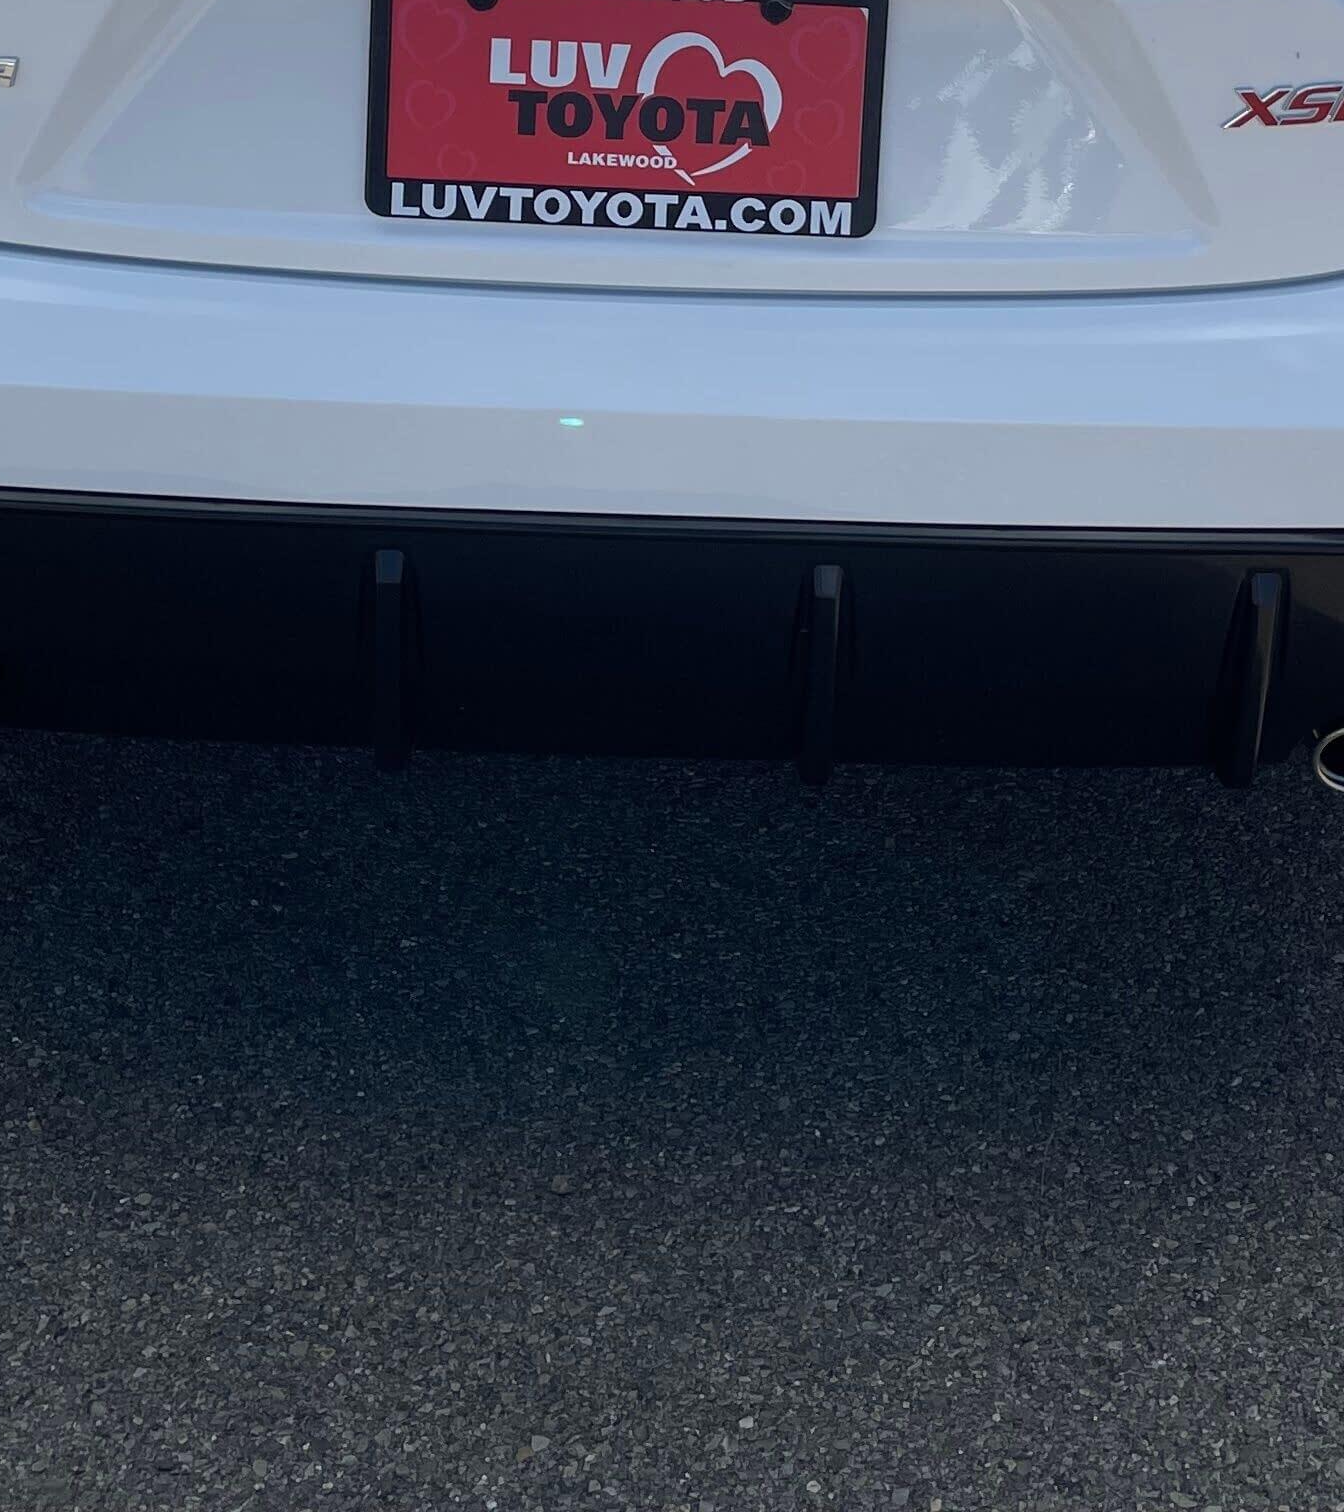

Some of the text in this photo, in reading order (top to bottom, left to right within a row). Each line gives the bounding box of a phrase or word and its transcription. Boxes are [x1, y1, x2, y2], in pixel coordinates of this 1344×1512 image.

[489, 37, 631, 89] LUV
[508, 89, 770, 147] TOYOTA
[567, 150, 678, 170] LAKEWOOD
[390, 181, 852, 237] LUVTOYOTA.COM
